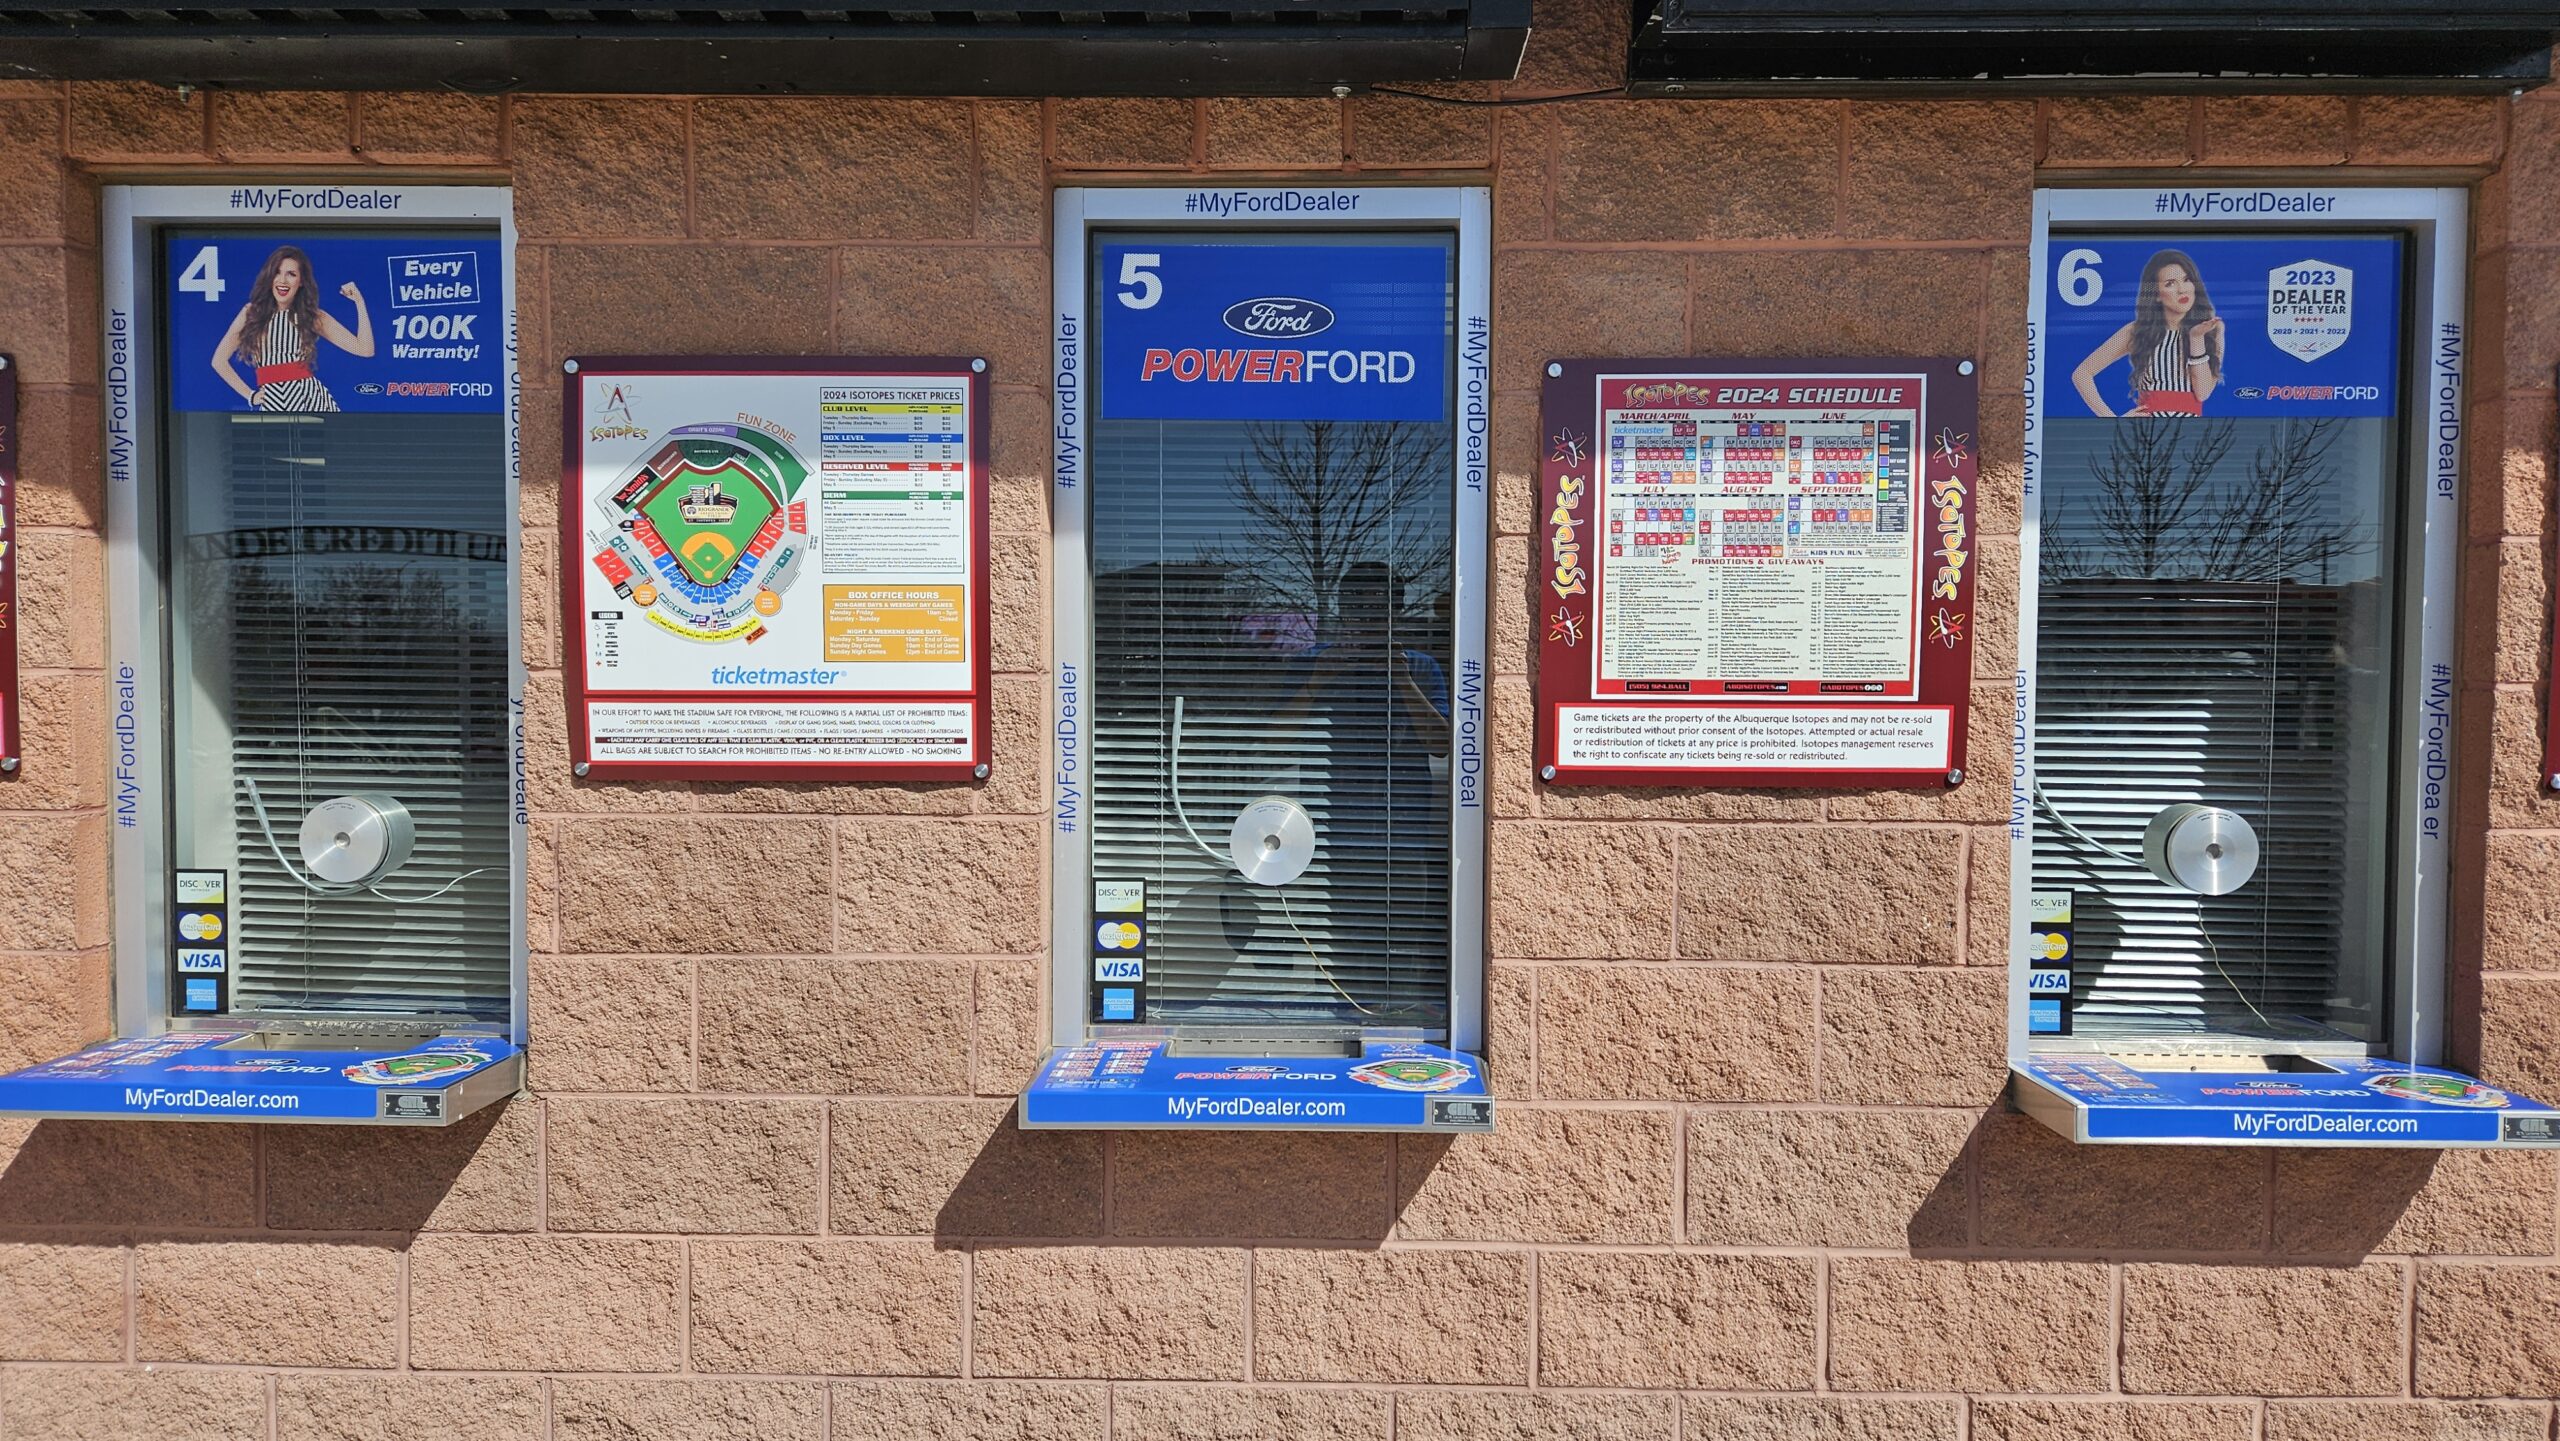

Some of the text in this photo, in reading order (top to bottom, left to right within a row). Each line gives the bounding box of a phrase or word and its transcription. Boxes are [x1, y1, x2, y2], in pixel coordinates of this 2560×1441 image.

[230, 189, 402, 214] #MyFordDealer
[1184, 192, 1360, 218] #MyFordDealer
[2155, 192, 2335, 218] #MyFordDealer
[178, 246, 226, 302] 4
[404, 258, 462, 278] Every
[2056, 248, 2103, 307] 6
[2286, 270, 2336, 285] 2023
[400, 282, 472, 302] Vehicle
[1117, 252, 1164, 310] 5
[2272, 290, 2346, 304] DEALER
[2272, 306, 2346, 314] OF THE YEAR
[392, 314, 477, 341] 100K
[392, 344, 480, 360] Warranty!
[1140, 348, 1416, 384] POWERFORD
[110, 308, 134, 482] #MyFordDealer
[823, 391, 960, 400] 2024 ISOTOPES TICKET PRICES
[1057, 313, 1081, 488] #MyFordDealer
[1467, 315, 1488, 493] #MyFordDealer
[1623, 382, 1903, 408] ISOTOPES 2024 SCHEDULE
[2436, 322, 2460, 500] #MyFordDealer
[737, 412, 797, 444] FUN ZONE
[1614, 426, 1665, 434] ticketmaster
[1550, 474, 1586, 599] ISOTOPES
[1932, 476, 1969, 600] ISOTOPES
[711, 666, 839, 684] ticketmaster
[1573, 712, 1598, 721] Game
[1601, 713, 1629, 721] tickets
[1664, 714, 1703, 724] property
[1705, 713, 1715, 722] of
[1717, 714, 1731, 722] the
[1733, 714, 1789, 724] Albuquerque
[1791, 714, 1829, 724] Isotopes
[1831, 715, 1848, 723] and
[1850, 716, 1868, 724] may
[1887, 715, 1899, 723] be
[1585, 726, 1641, 734] redistributed
[1643, 726, 1675, 734] without
[1678, 726, 1699, 735] prior
[1738, 726, 1747, 734] of
[1750, 726, 1763, 735] the
[1766, 726, 1805, 736] Isotopes.
[1808, 727, 1855, 736] Attempted
[116, 661, 141, 828] #MyFordDeale
[1058, 662, 1081, 833] #MyFordDealer
[1585, 737, 1642, 746] redistribution
[1645, 738, 1654, 746] of
[1657, 738, 1685, 746] tickets
[1716, 738, 1738, 748] price
[1750, 739, 1797, 748] prohibited.
[1801, 739, 1838, 748] Isotopes
[1841, 740, 1895, 749] management
[1589, 750, 1608, 760] right
[1623, 750, 1666, 758] confiscate
[1686, 750, 1714, 759] tickets
[1717, 751, 1741, 761] being
[1789, 751, 1846, 759] redistributed.
[184, 954, 222, 968] VISA
[1102, 963, 1140, 977] VISA
[2030, 974, 2067, 988] VISA
[125, 1088, 299, 1111] MyFordDealer.com
[1168, 1097, 1346, 1118] MyFordDealer.com
[2234, 1113, 2418, 1136] MyFordDealer.com
